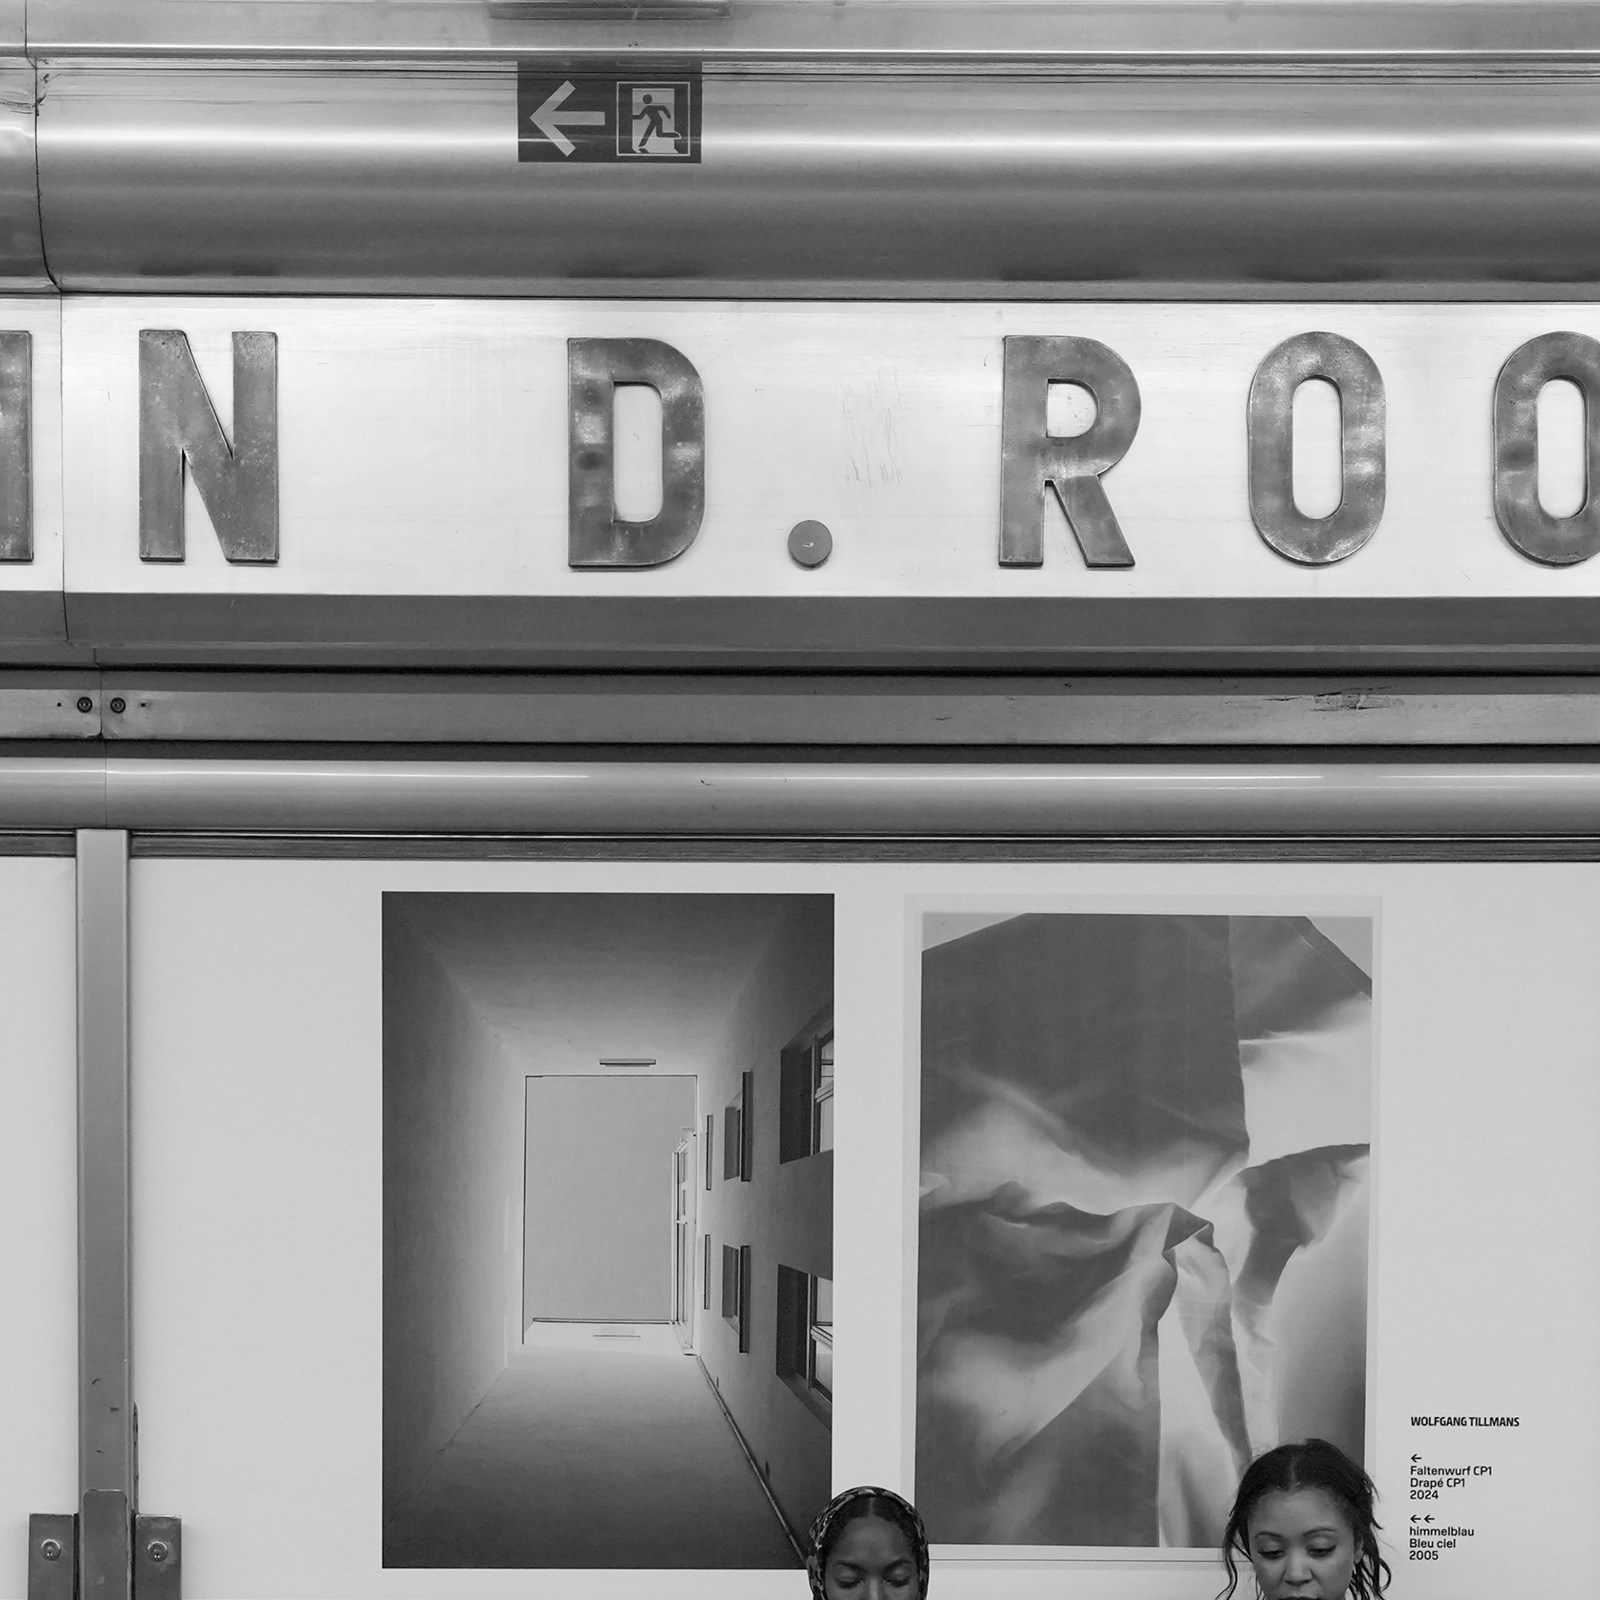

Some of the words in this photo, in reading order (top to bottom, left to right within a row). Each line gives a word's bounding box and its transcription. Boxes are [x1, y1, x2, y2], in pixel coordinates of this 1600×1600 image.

[566, 336, 834, 570] D.
[1411, 1417, 1467, 1426] WOLFGANG
[1469, 1417, 1519, 1427] TILLMANS
[1411, 1466, 1471, 1475] Faltenwurf
[1473, 1466, 1491, 1475] CP1
[1410, 1478, 1443, 1489] Drapé
[1447, 1478, 1465, 1487] CP1
[1410, 1490, 1439, 1499] 2024
[1410, 1526, 1474, 1536] himmelblau
[1410, 1538, 1434, 1548] Bleu
[1437, 1539, 1456, 1548] ciel
[1410, 1550, 1438, 1560] 2005
